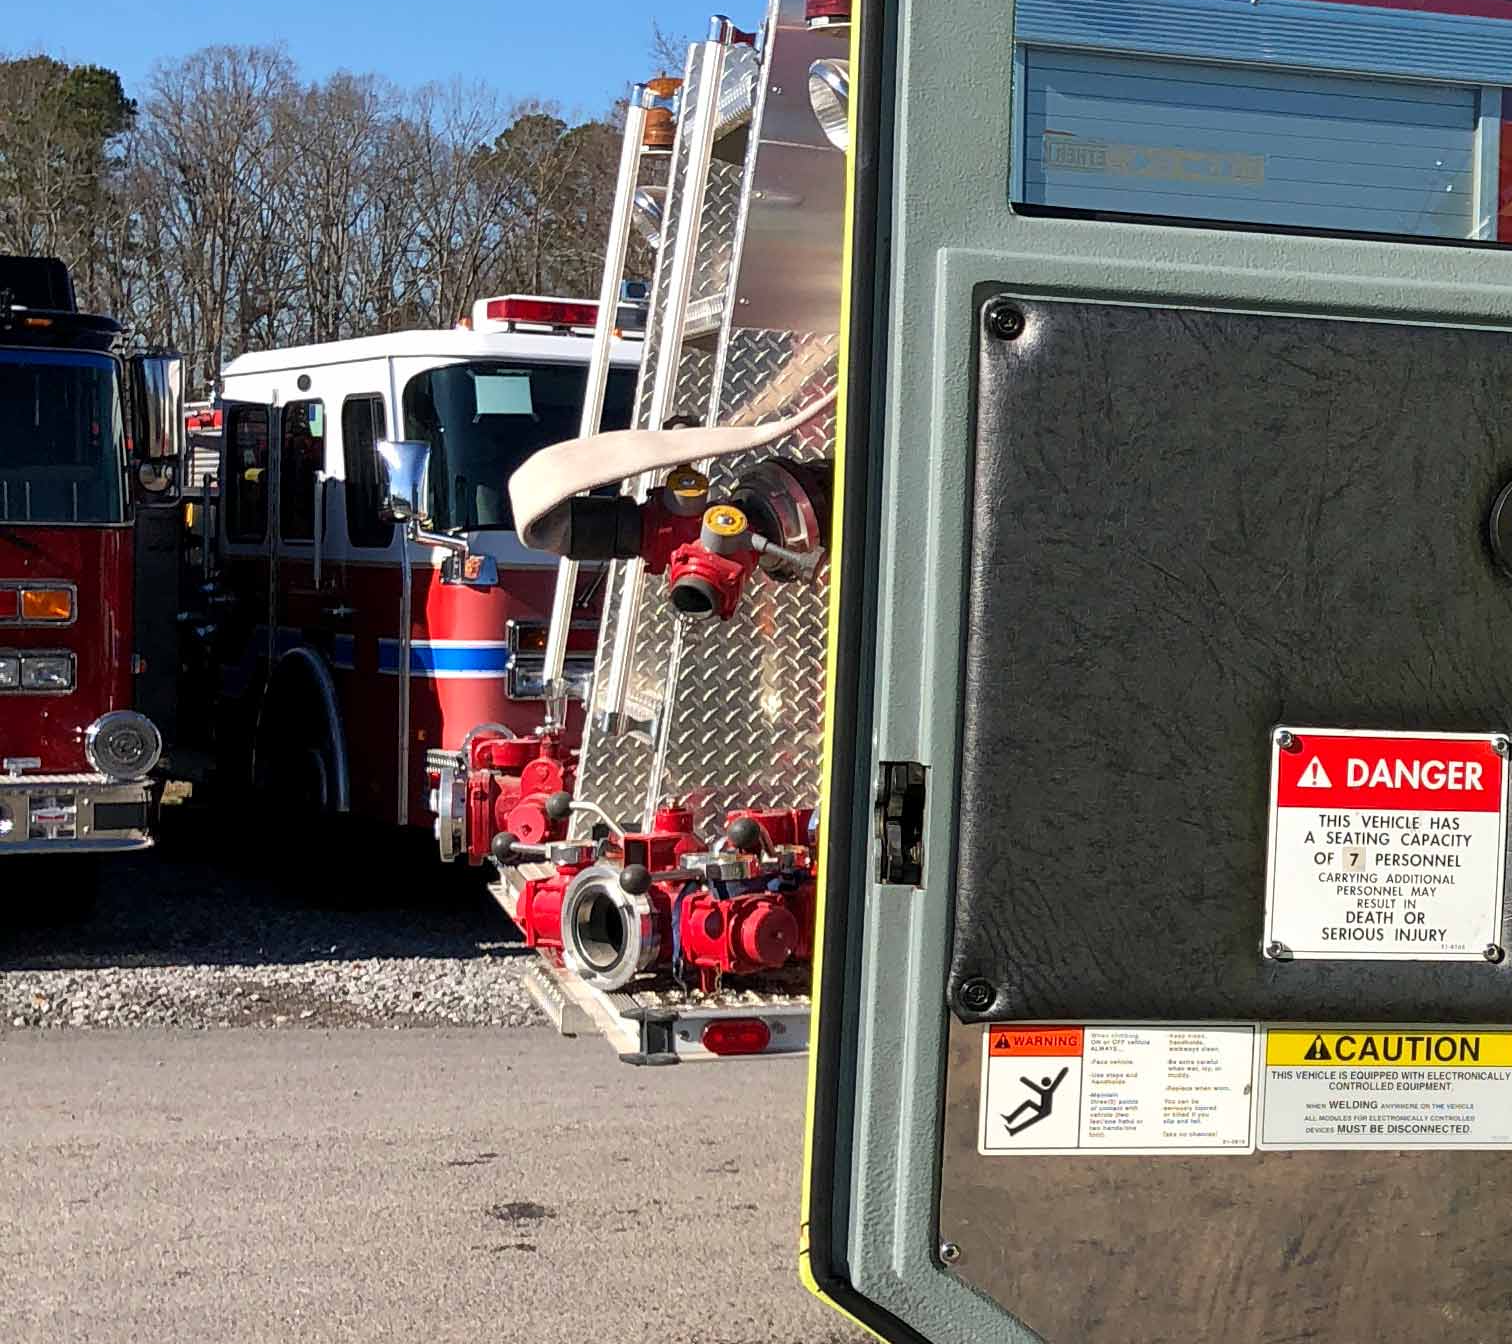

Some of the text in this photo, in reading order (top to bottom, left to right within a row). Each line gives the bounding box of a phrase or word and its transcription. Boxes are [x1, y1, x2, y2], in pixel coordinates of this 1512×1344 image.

[1347, 758, 1483, 791] DANGER
[1319, 814, 1460, 830] THIS VEHICLE HAS
[1304, 831, 1472, 847] A SEATING CAPACITY
[1314, 852, 1461, 867] OF 7 PERSONNEL
[1318, 873, 1455, 885] CARRYING ADDITIONAL
[1337, 886, 1437, 896] PERSONNEL MAY
[1357, 899, 1416, 909] RESULT IN
[1346, 912, 1425, 924] DEATH OR
[1322, 928, 1447, 942] SERIOUS INJURY
[1013, 1035, 1079, 1049] WARNING
[1335, 1036, 1480, 1061] CAUTION
[1272, 1071, 1511, 1081] THIS VEHICLE IS EQUIPPED WITH ELECTRONICALLY
[1328, 1082, 1394, 1090] CONTROLLED
[1329, 1101, 1377, 1109] WELDING
[1337, 1125, 1368, 1133] MUST
[1370, 1125, 1384, 1133] BE
